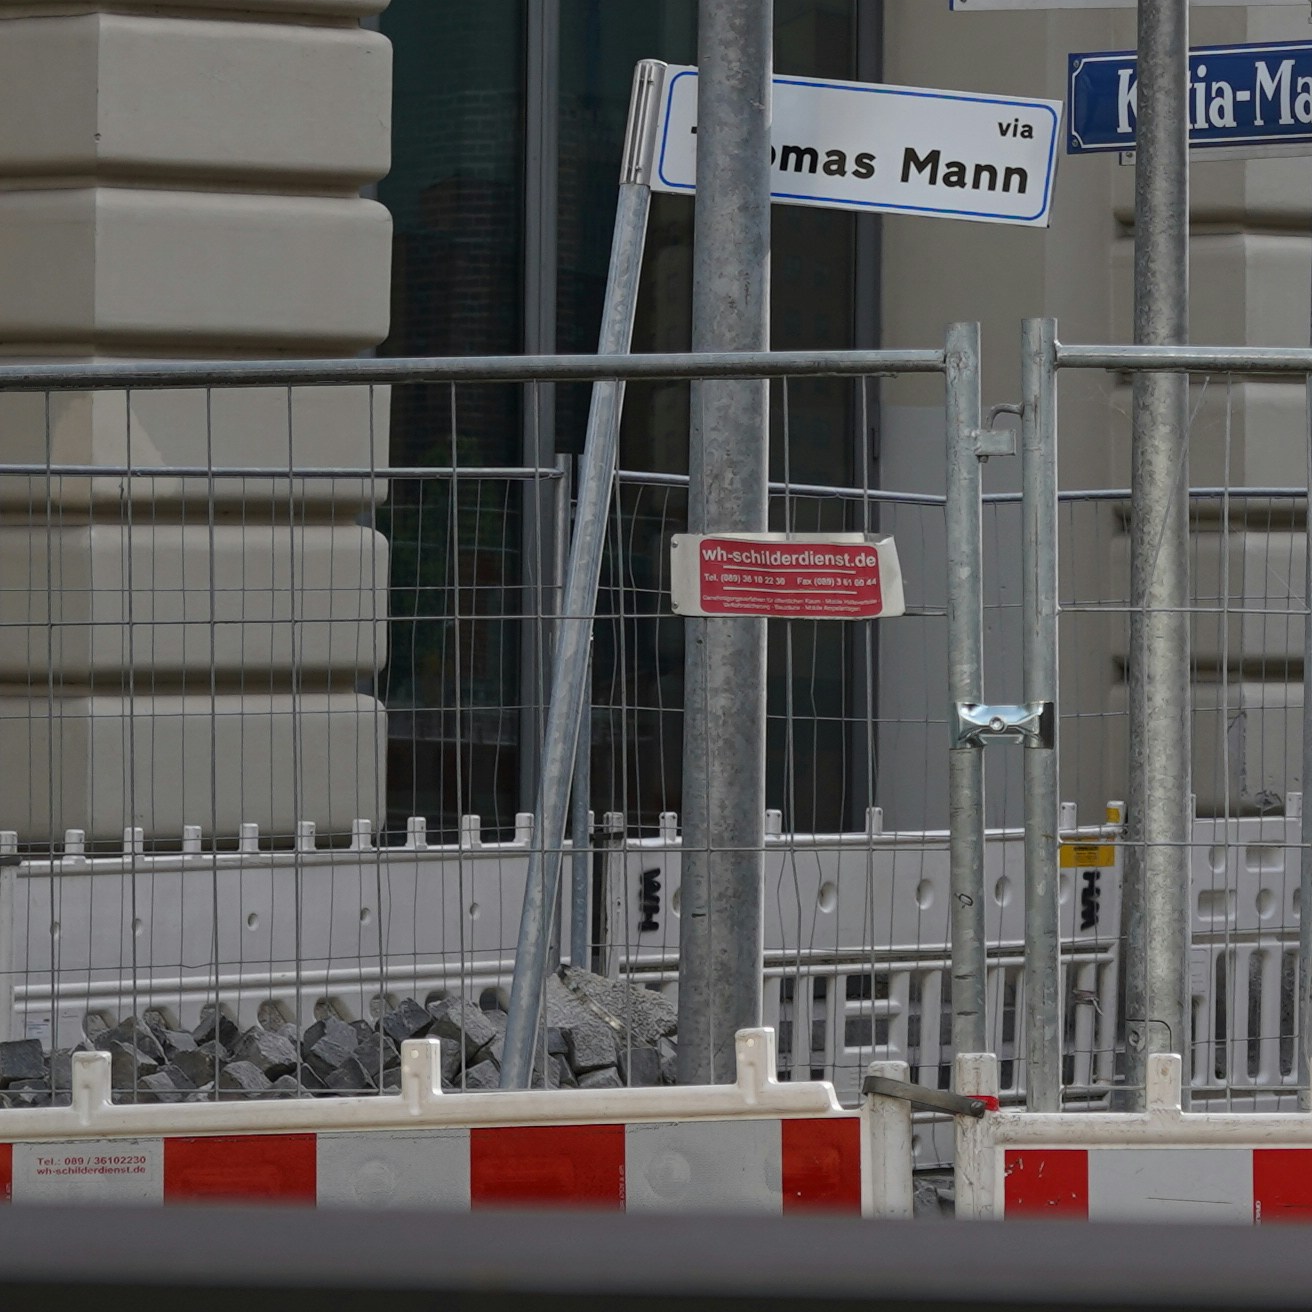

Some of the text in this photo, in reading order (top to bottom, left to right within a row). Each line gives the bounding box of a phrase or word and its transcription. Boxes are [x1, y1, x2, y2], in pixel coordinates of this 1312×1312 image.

[997, 118, 1034, 140] via
[900, 147, 1029, 194] Mann
[702, 546, 876, 567] wh-schilderdienst.de
[704, 573, 719, 582] Tel.
[797, 577, 812, 586] Fax
[64, 1157, 84, 1166] 089
[94, 1156, 146, 1166] 36102230
[37, 1166, 146, 1175] wh-schilderdienst.de
